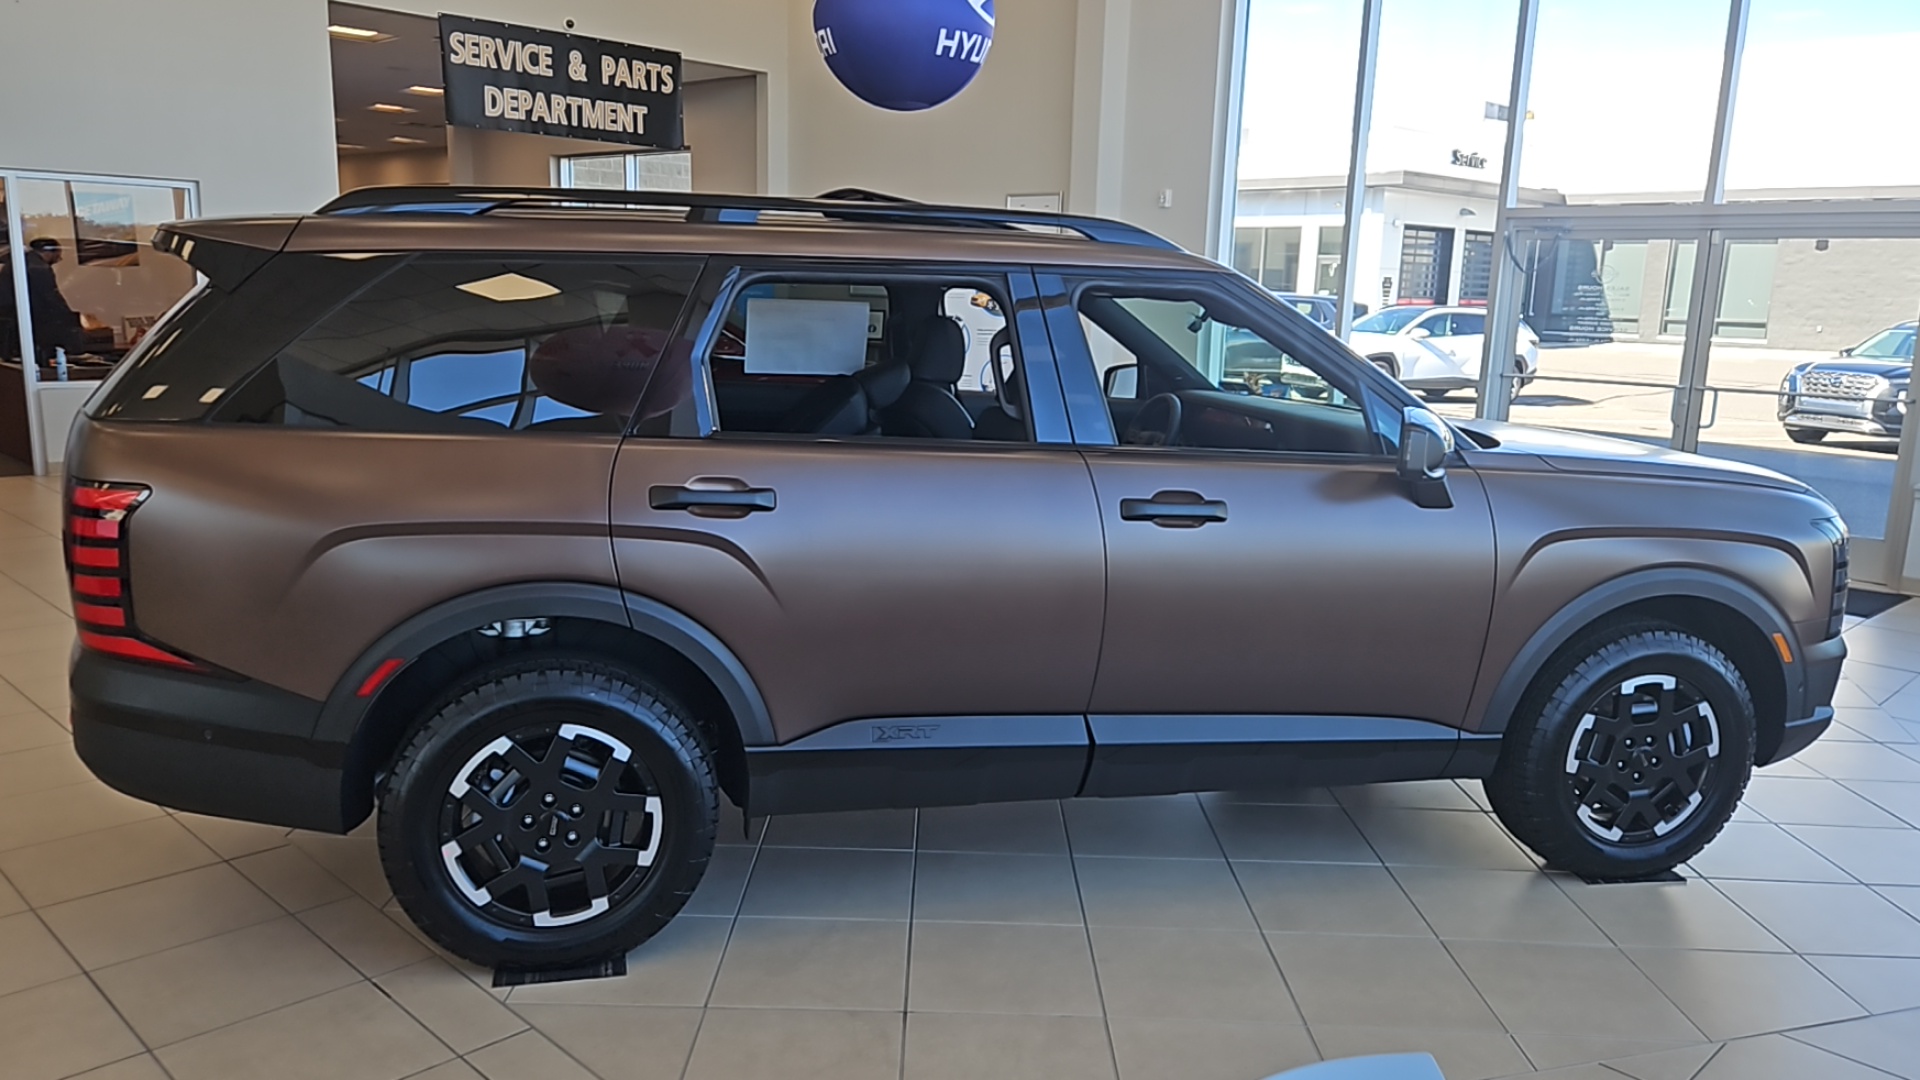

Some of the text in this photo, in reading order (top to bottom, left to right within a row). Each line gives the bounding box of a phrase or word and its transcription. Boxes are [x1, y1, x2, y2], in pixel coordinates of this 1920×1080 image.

[449, 31, 674, 94] SERVICE & PARTS
[484, 84, 648, 135] DEPARTMENT
[872, 724, 941, 743] XRT
